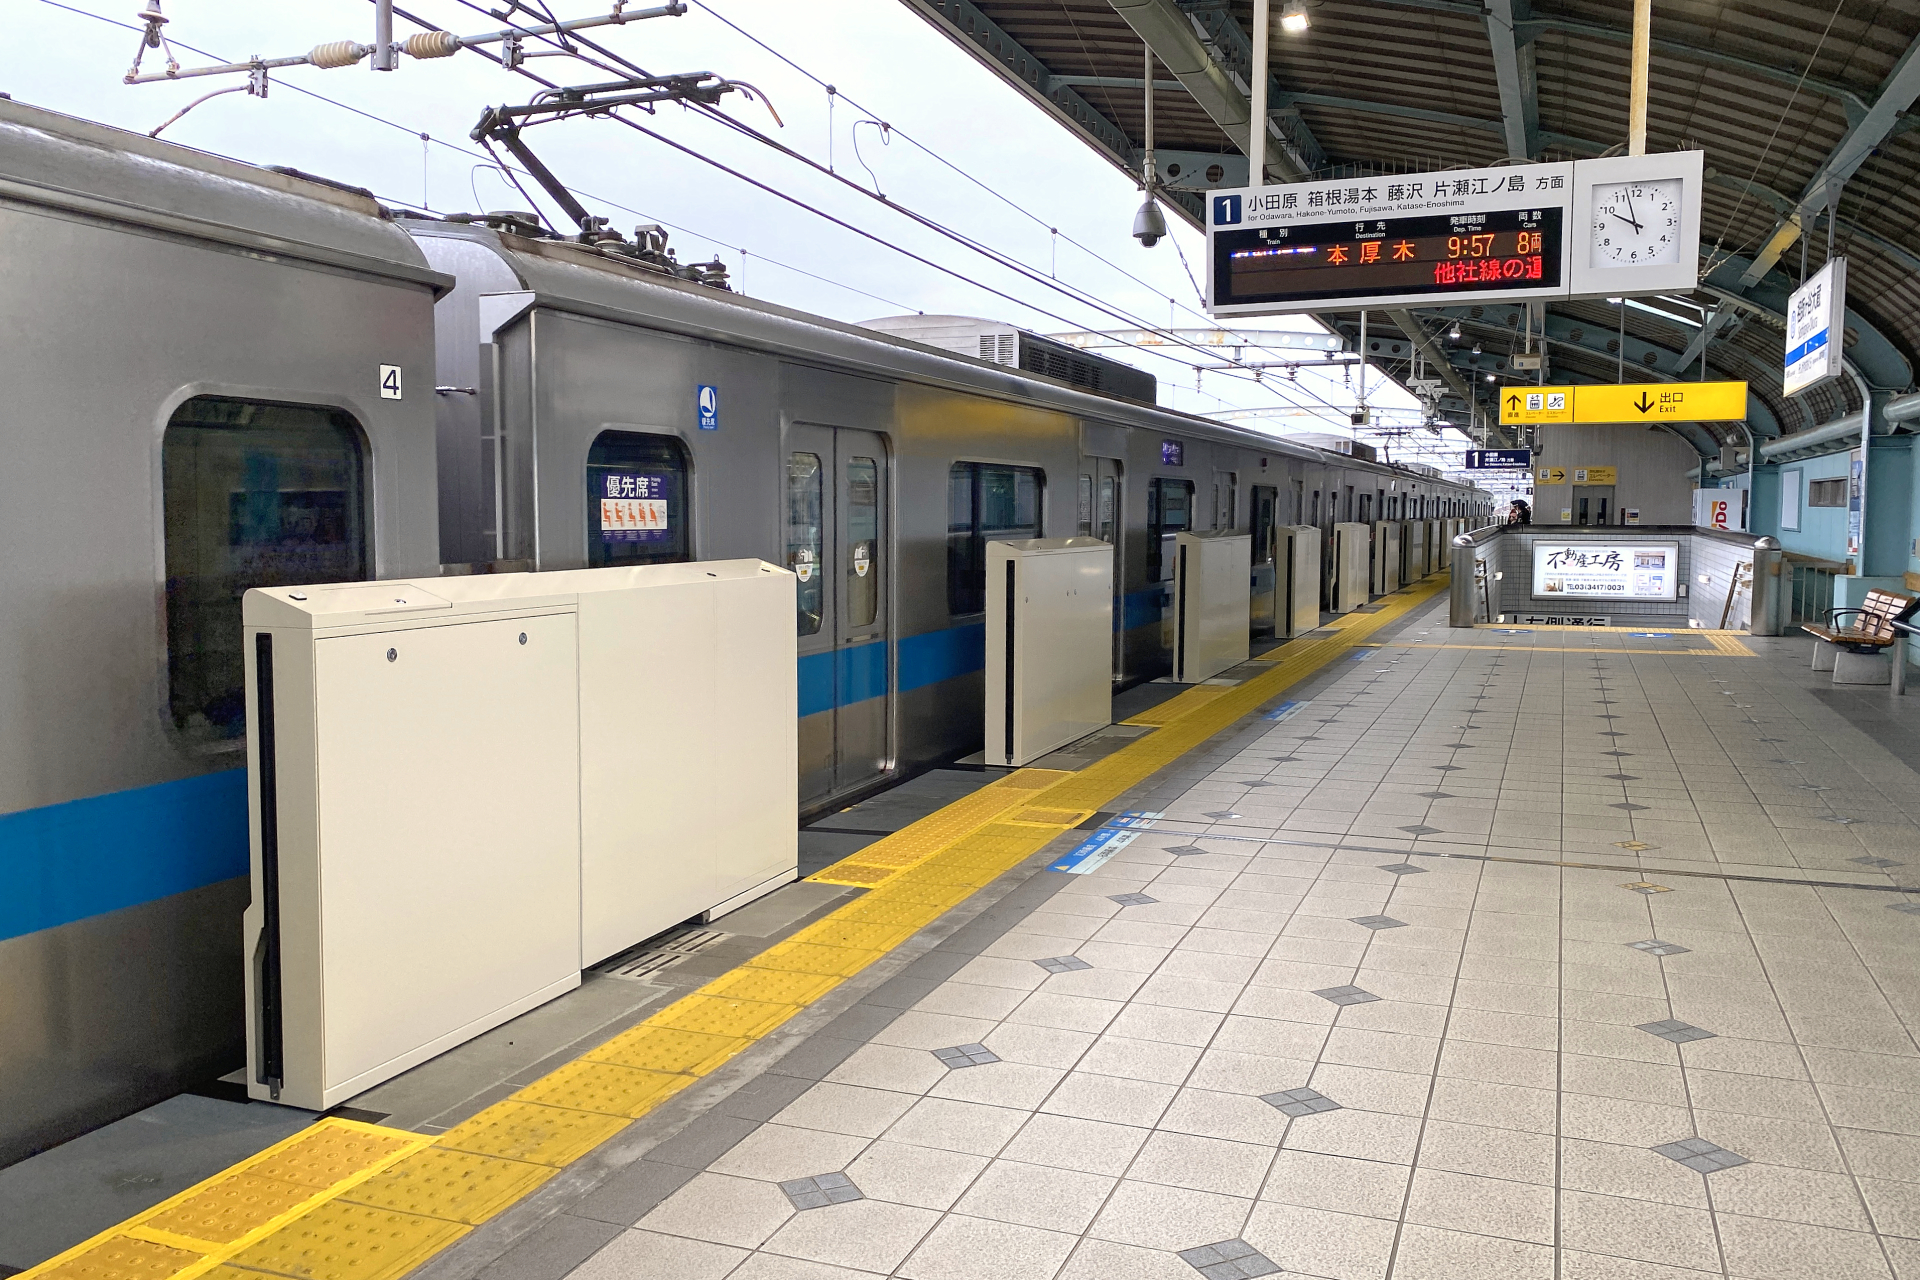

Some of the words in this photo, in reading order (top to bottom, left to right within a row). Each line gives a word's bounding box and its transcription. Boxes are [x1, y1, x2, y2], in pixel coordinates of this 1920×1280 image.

[1248, 192, 1298, 212] 小田原
[1307, 185, 1378, 208] 箱根湯本
[1387, 182, 1423, 202] 藤沢
[1433, 174, 1525, 198] 片瀬江ノ島
[1535, 175, 1565, 190] 方面
[1631, 189, 1642, 198] 12
[1615, 194, 1626, 203] 11
[1222, 198, 1231, 222] 1
[1247, 213, 1258, 222] for
[1259, 211, 1294, 221] Odawara,
[1296, 206, 1358, 218] Hakone-Yumoto,
[1359, 203, 1394, 214] Fujisawa,
[1396, 198, 1465, 211] Katase-Enoshima
[1604, 206, 1615, 214] 10
[1661, 202, 1668, 211] 2
[1449, 213, 1486, 226] 発車時刻
[1518, 210, 1542, 222] 両数
[1355, 221, 1386, 231] 行先
[1598, 222, 1605, 231] 9
[1666, 218, 1673, 227] 3
[1258, 228, 1289, 239] 種別
[1355, 231, 1386, 240] Destination
[1659, 234, 1666, 242] 4
[1266, 238, 1281, 246] Train
[1447, 233, 1495, 259] 9:57
[1517, 231, 1542, 255] 8両
[1603, 238, 1610, 246] 8
[1616, 247, 1622, 256] 7
[1630, 250, 1637, 259] 6
[1647, 246, 1654, 254] 5
[382, 369, 400, 396] 4
[1659, 391, 1684, 403] 出口
[1659, 405, 1676, 413] Exit
[1471, 451, 1479, 468] 1
[606, 474, 649, 498] 優先席
[1546, 547, 1625, 572] 不動産工房
